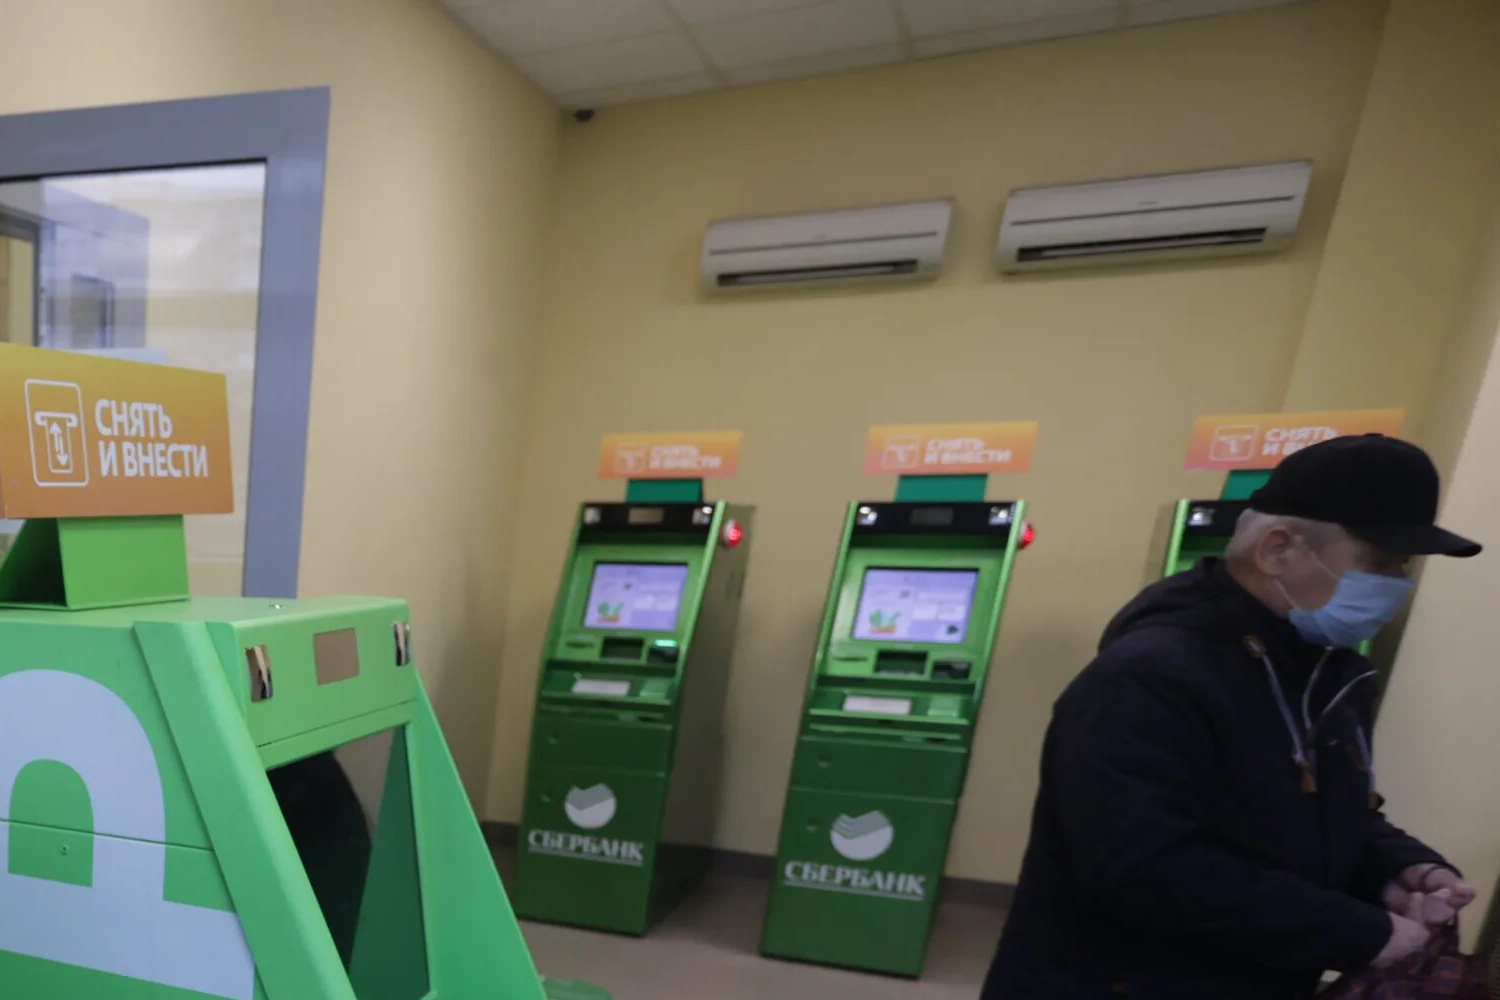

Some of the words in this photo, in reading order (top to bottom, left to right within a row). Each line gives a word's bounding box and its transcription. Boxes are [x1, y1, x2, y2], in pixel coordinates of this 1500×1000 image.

[94, 398, 173, 438] СНЯТЬ
[98, 440, 119, 478] И
[123, 442, 209, 478] ВНЕСТИ
[940, 449, 1011, 465] ВНЕСТИ
[528, 830, 644, 862] СБЕРБАНК
[784, 861, 925, 896] СБЕРБАНК
